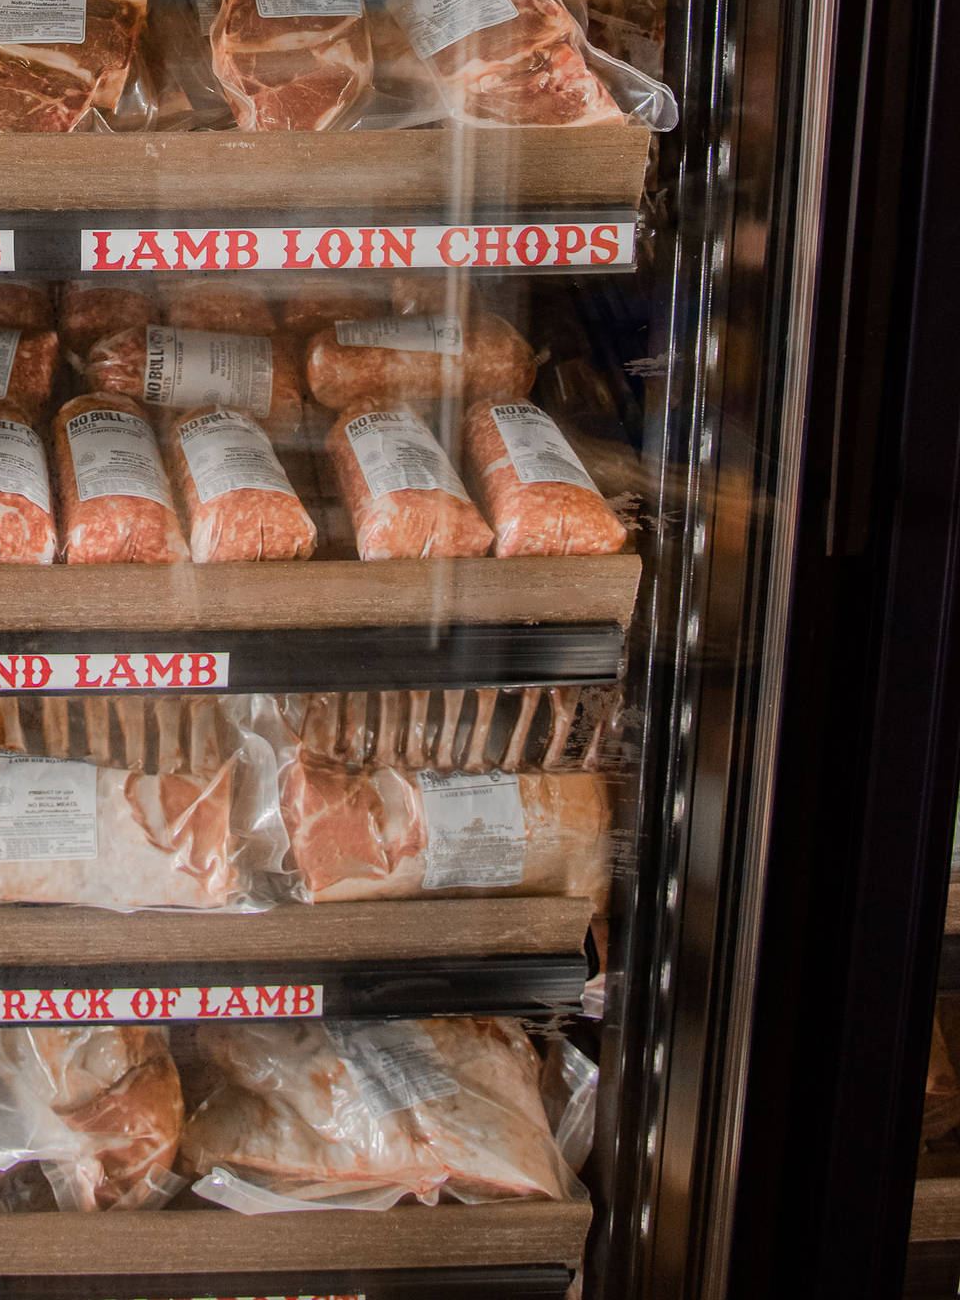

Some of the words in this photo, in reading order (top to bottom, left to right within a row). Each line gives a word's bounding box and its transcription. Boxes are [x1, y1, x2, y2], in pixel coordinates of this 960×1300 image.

[92, 231, 259, 270] LAMB
[281, 229, 416, 269] LOIN
[437, 226, 619, 267] CHOPS
[149, 351, 164, 381] BULL
[145, 382, 161, 401] NO
[69, 415, 89, 431] NO
[90, 412, 126, 423] BULL
[348, 417, 368, 433] NO
[369, 412, 404, 423] BULL
[495, 406, 516, 416] NO
[180, 420, 198, 435] NO
[201, 412, 235, 425] BULL
[74, 653, 217, 688] LAMB
[2, 988, 113, 1020] RACK
[130, 987, 181, 1019] OF
[197, 985, 315, 1017] LAMB
